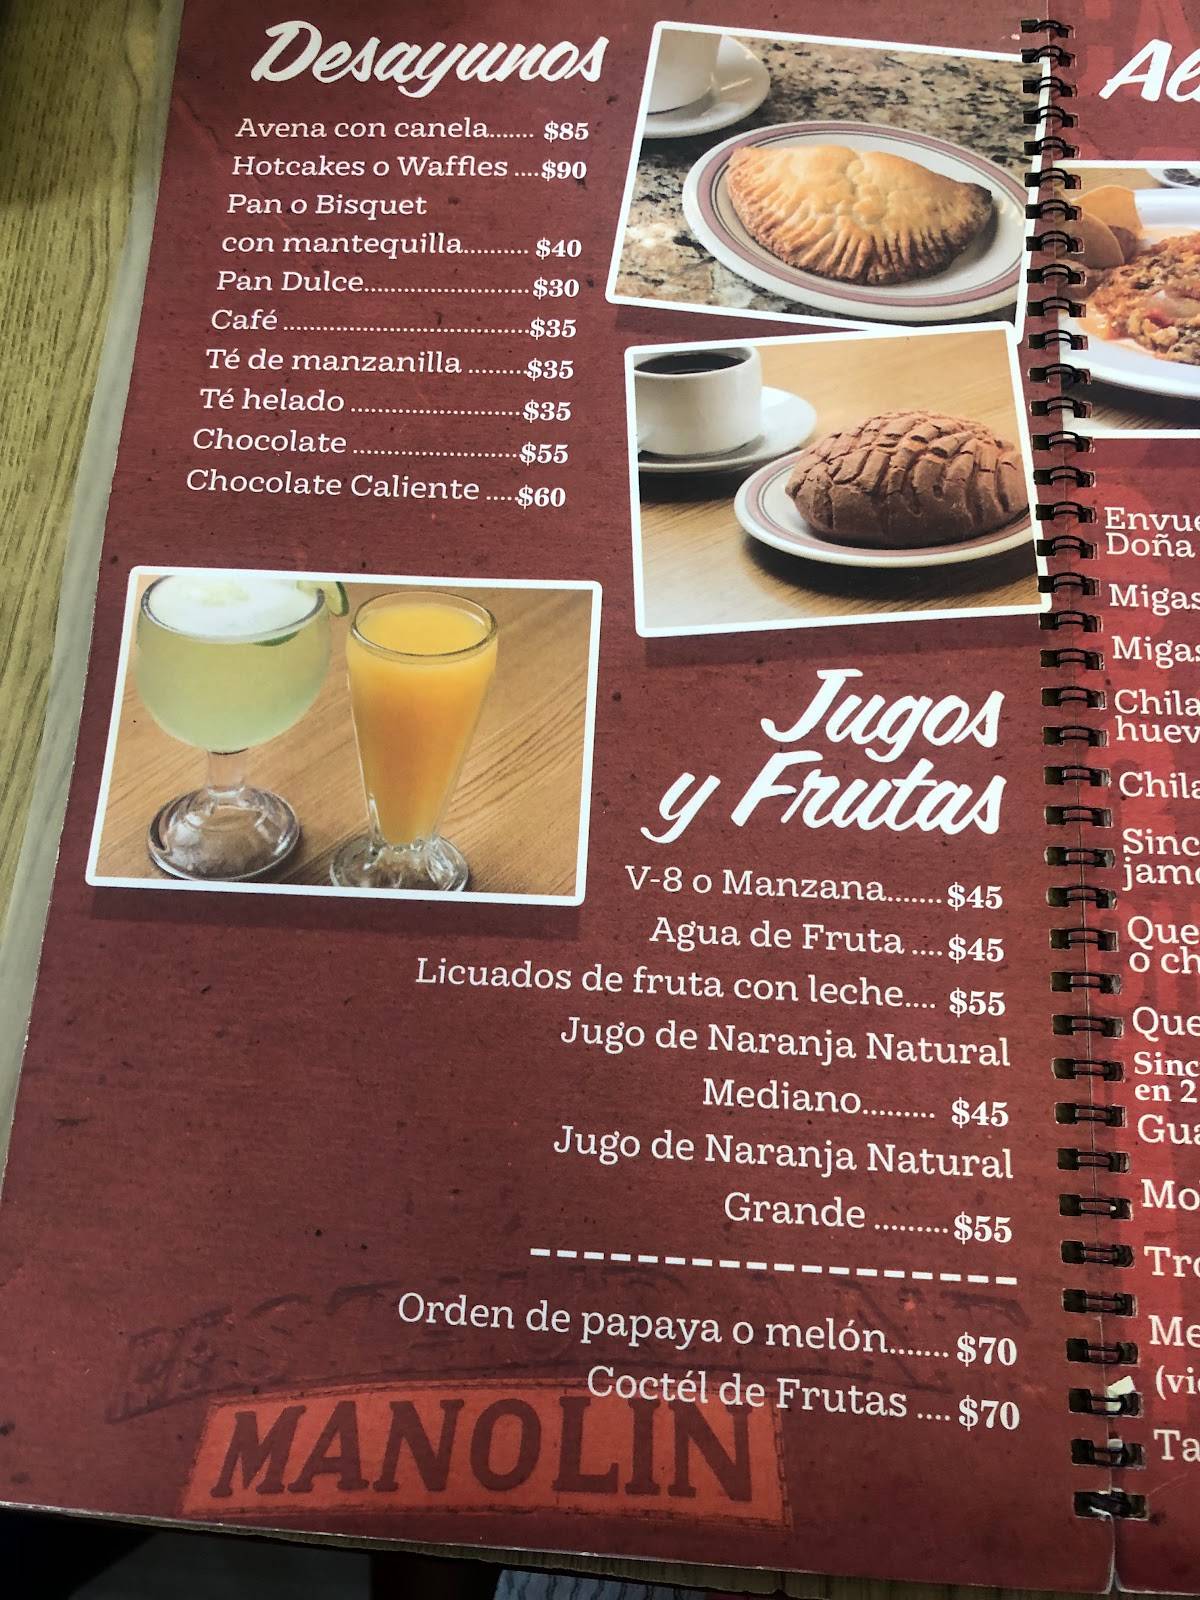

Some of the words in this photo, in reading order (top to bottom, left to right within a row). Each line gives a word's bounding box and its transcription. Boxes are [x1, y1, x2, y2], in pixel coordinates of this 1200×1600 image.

[250, 19, 610, 99] Desayunos
[234, 117, 328, 138] Avena
[333, 122, 387, 138] con
[543, 119, 590, 144] $85
[231, 154, 366, 177] Hotcakes
[372, 160, 390, 177] o
[396, 154, 508, 177] Waffles
[540, 158, 588, 182] $90
[226, 193, 283, 215] Pan
[290, 198, 308, 215] o
[314, 193, 428, 221] Bisquet
[221, 236, 275, 253] con
[535, 236, 583, 261] $40
[216, 270, 273, 292] Pan
[532, 276, 580, 301] $30
[210, 308, 278, 331] Café
[529, 316, 577, 341] $35
[205, 347, 241, 370] Té
[247, 347, 284, 371] de
[290, 350, 463, 374] manzanilla
[522, 357, 574, 382] $35
[199, 387, 235, 410] Té
[241, 387, 345, 412] helado
[521, 398, 572, 424] $35
[192, 427, 347, 454] Chocolate
[518, 440, 569, 467] $55
[186, 468, 343, 496] Chocolate
[350, 474, 480, 501] Caliente
[514, 483, 567, 510] $60
[1105, 531, 1196, 559] Doña
[1108, 583, 1200, 617] Migas
[759, 668, 1006, 762] Jugos
[1114, 714, 1200, 744] huev
[639, 771, 722, 845] y
[730, 750, 1008, 836] Frutas
[1122, 827, 1200, 857] Sinc
[624, 864, 683, 893] V-8
[692, 873, 713, 894] o
[946, 881, 1004, 912] $45
[1121, 856, 1200, 892] jam
[648, 916, 742, 953] Agua
[749, 919, 792, 949] de
[801, 923, 906, 955] Fruta
[947, 933, 1005, 965] $45
[1127, 915, 1200, 950] Que
[1128, 951, 1151, 973] o
[1160, 945, 1200, 975] ch
[415, 957, 572, 990] Licuados
[581, 963, 624, 993] de
[632, 965, 725, 998] fruta
[733, 978, 800, 1002] con
[948, 986, 1006, 1019] $55
[560, 1016, 646, 1055] Jugo
[655, 1019, 698, 1050] de
[707, 1023, 857, 1067] Naranja
[865, 1031, 1011, 1067] Natural
[1132, 1006, 1200, 1043] Que
[1133, 1050, 1200, 1078] Sinc
[587, 1365, 709, 1405] Coctél
[718, 1372, 766, 1408] de
[775, 750, 908, 1418] Frutas
[958, 1394, 1020, 1432] $70
[1134, 1083, 1173, 1102] en
[1179, 1078, 1198, 1104] 2
[951, 1096, 1010, 1129] $45
[1137, 1113, 1200, 1146] Gu
[553, 1124, 641, 1166] Jugo
[651, 1129, 695, 1161] de
[704, 1133, 858, 1179] Naranja
[866, 1142, 1014, 1179] Natural
[724, 1191, 866, 1229] Grande
[953, 1210, 1013, 1246] $55
[398, 1291, 515, 1330] Orden
[525, 1299, 571, 1333] de
[579, 1311, 723, 1351] papaya
[732, 1321, 754, 1345] o
[956, 1331, 1018, 1368] $70
[1147, 1314, 1200, 1349] Me
[1155, 1364, 1200, 1401] (vi
[208, 1395, 755, 1502] MANOLIN
[1152, 1428, 1200, 1463] Ta
